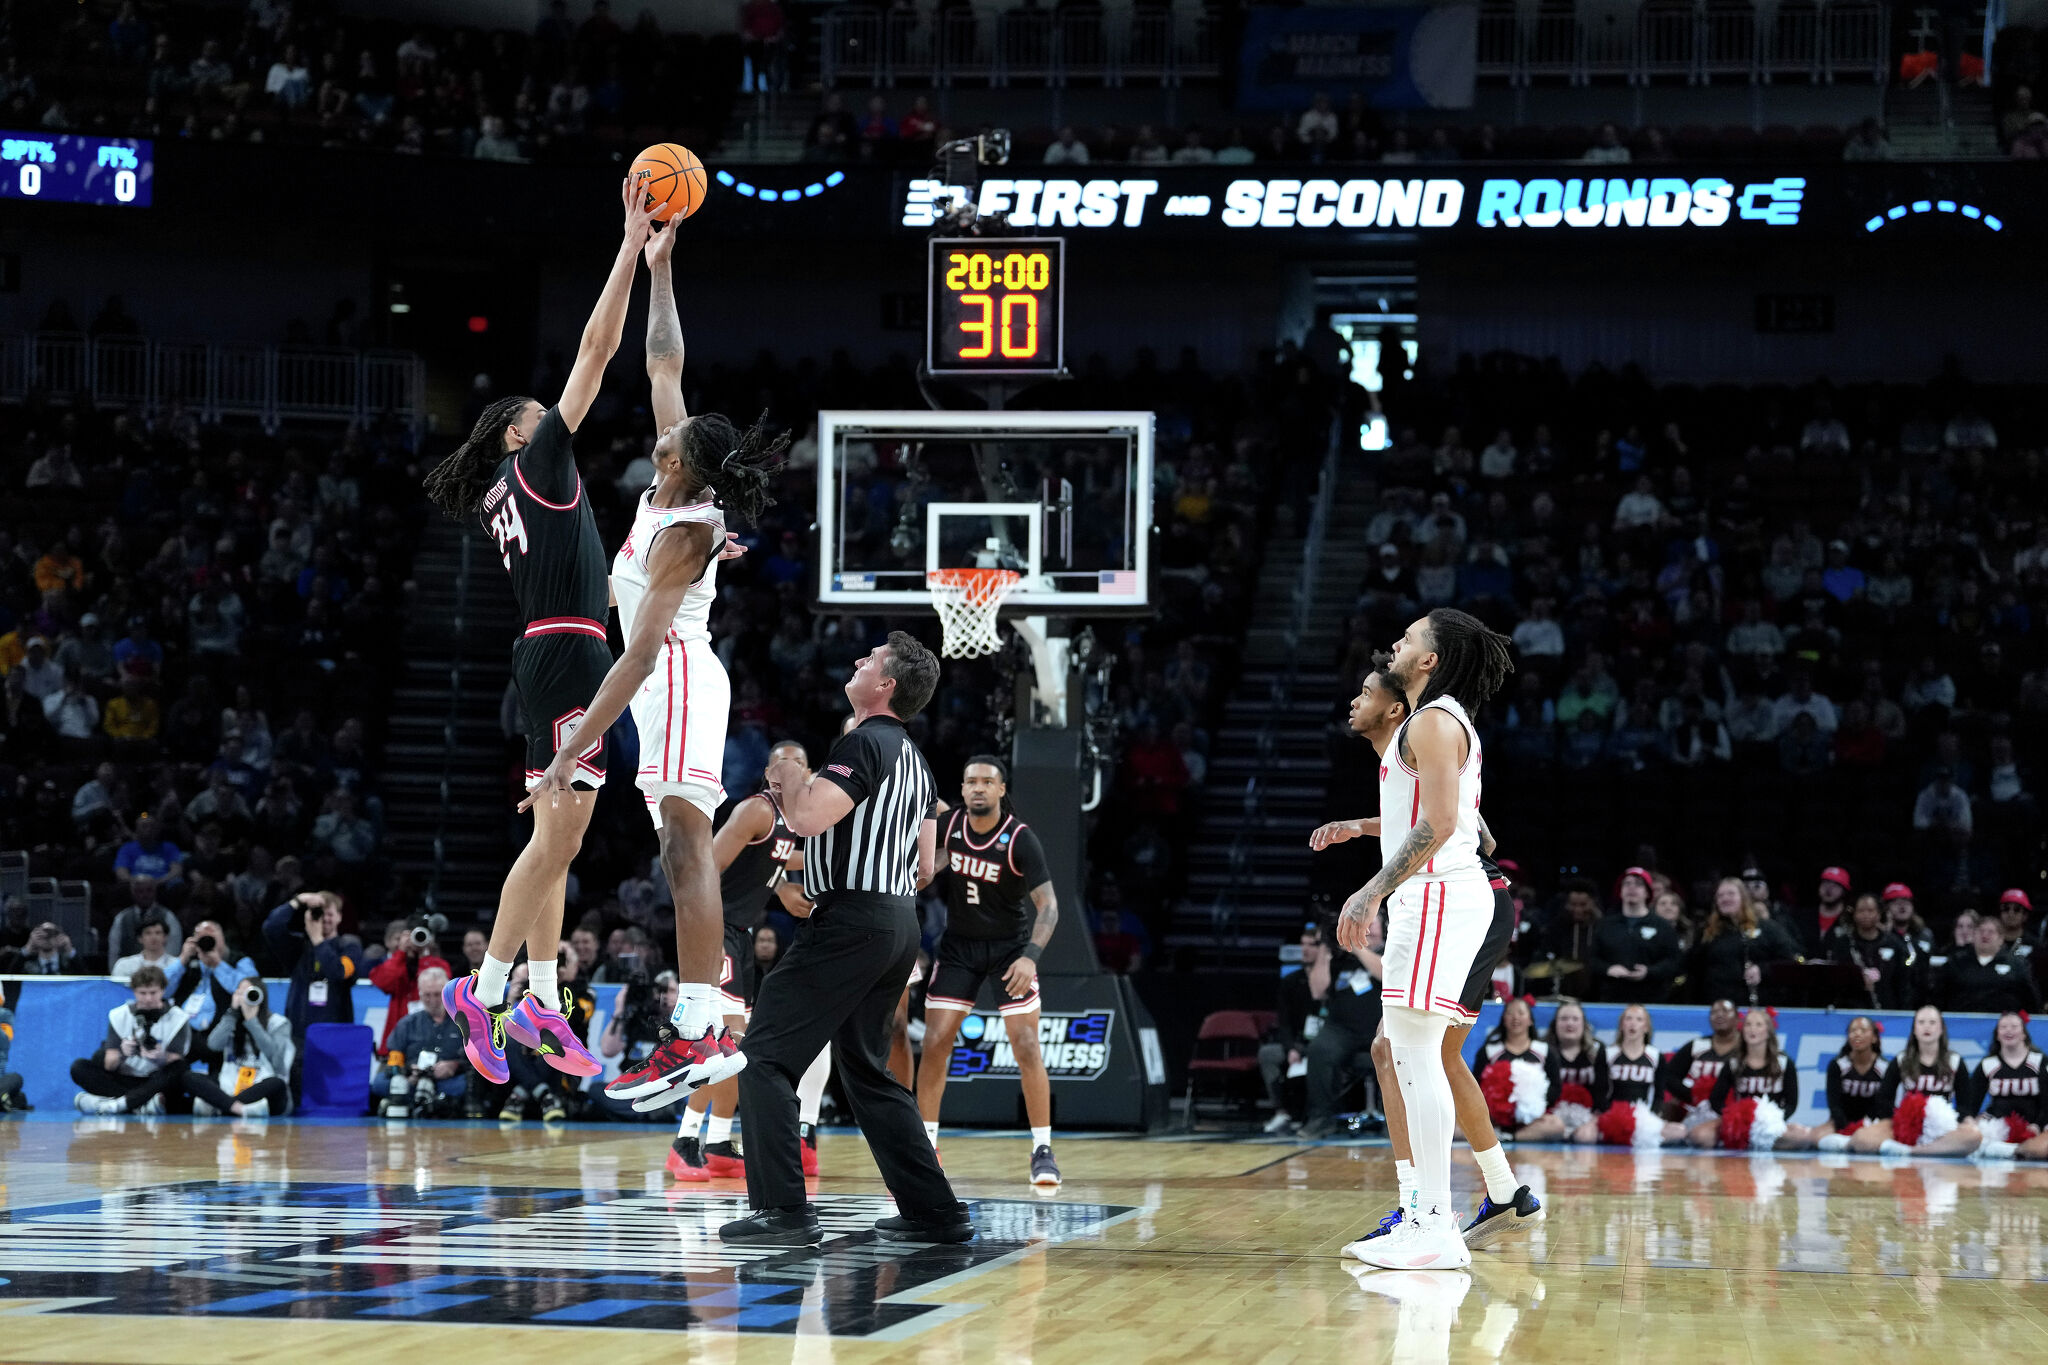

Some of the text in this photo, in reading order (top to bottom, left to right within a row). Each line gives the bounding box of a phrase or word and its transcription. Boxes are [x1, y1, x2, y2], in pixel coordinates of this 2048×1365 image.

[20, 164, 136, 202] 0 0
[977, 179, 1158, 227] FIRST
[1222, 179, 1464, 227] SECOND
[1477, 178, 1734, 227] ROUNDS
[946, 253, 1050, 291] 20:00
[959, 294, 1039, 358] 30
[949, 851, 1001, 884] SIUE
[967, 881, 980, 905] 3
[983, 1016, 1068, 1043] MCH
[992, 1042, 1106, 1069] MNESS
